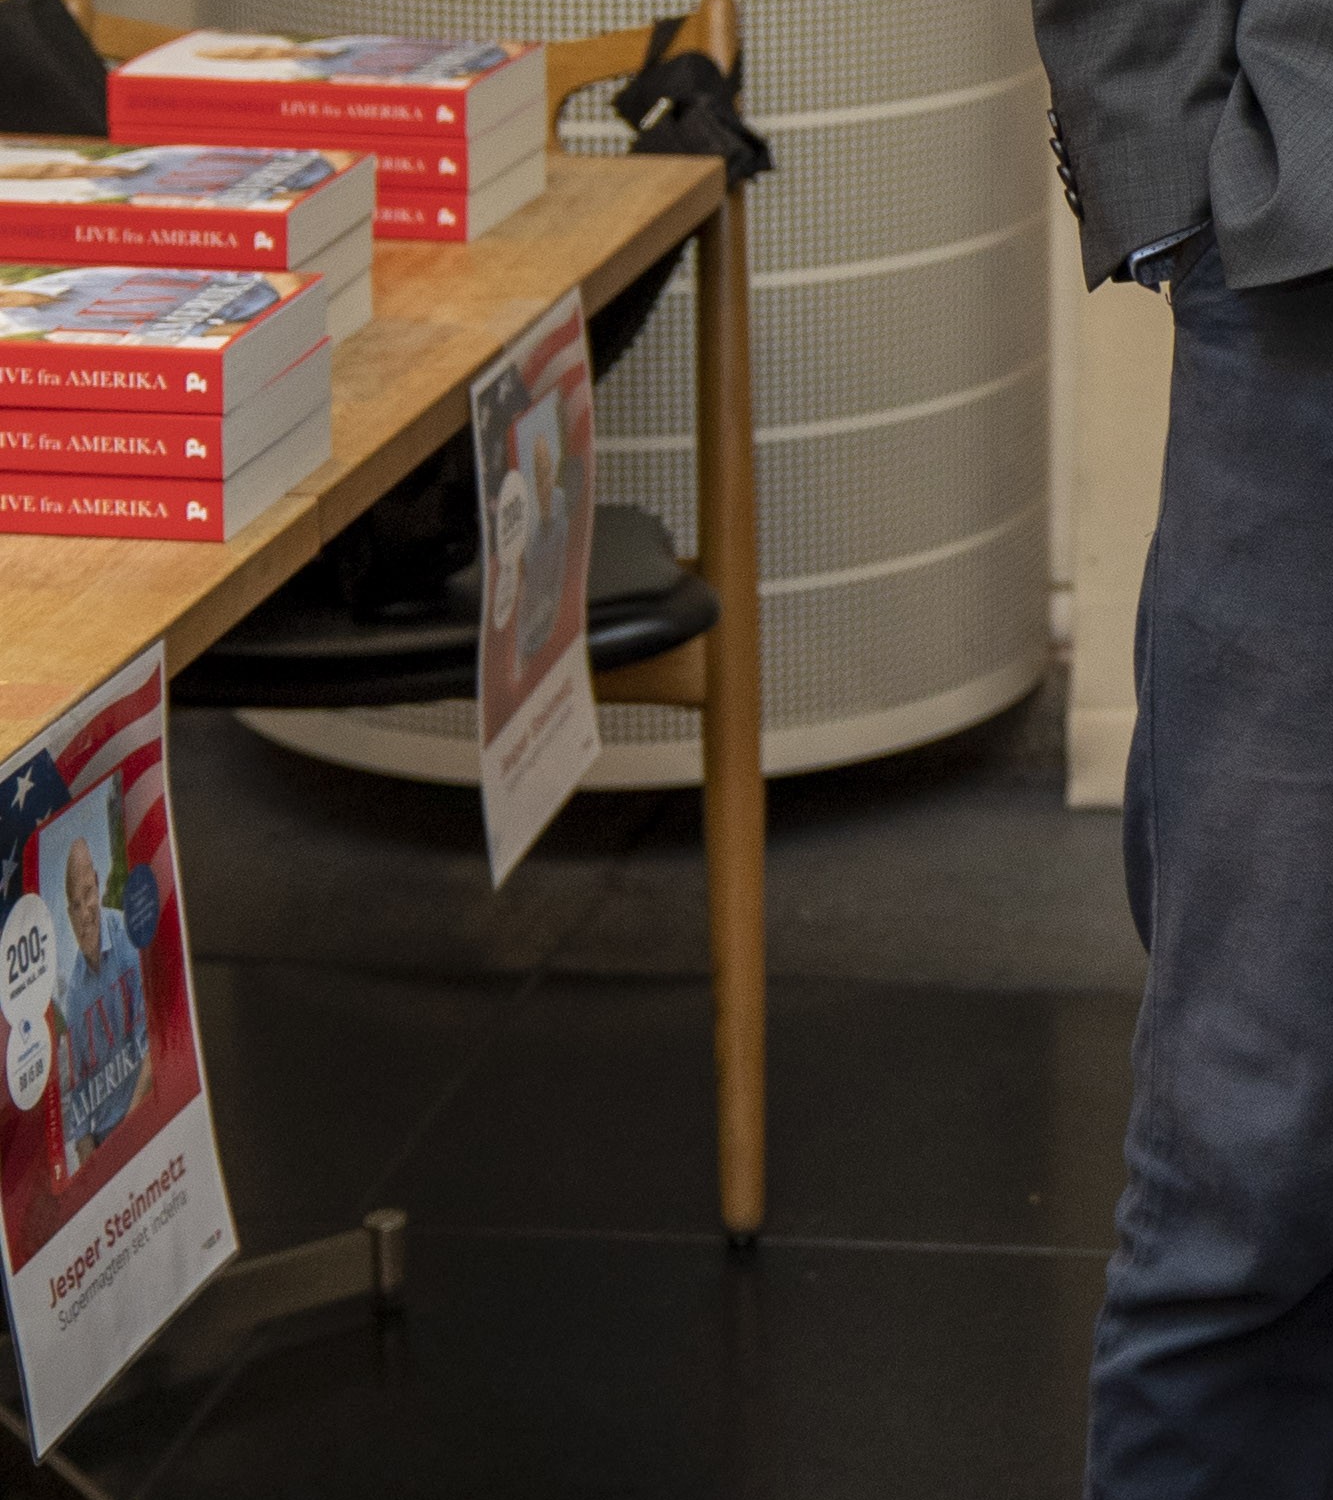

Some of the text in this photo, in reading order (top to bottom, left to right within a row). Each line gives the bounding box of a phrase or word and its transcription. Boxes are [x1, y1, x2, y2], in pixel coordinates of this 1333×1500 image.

[75, 225, 119, 244] LIVE
[122, 228, 144, 244] fra
[149, 229, 238, 249] AMERIKA
[0, 366, 33, 386] IVE
[37, 369, 61, 387] fra
[65, 370, 168, 390] AMERIKA
[0, 431, 34, 450] IVE
[38, 434, 62, 451] fra
[66, 435, 168, 456] AMERIKA
[0, 494, 36, 513] IVE
[39, 498, 63, 514] fra
[67, 499, 169, 519] AMERIKA
[50, 1153, 187, 1309] Jesper Steinmetz
